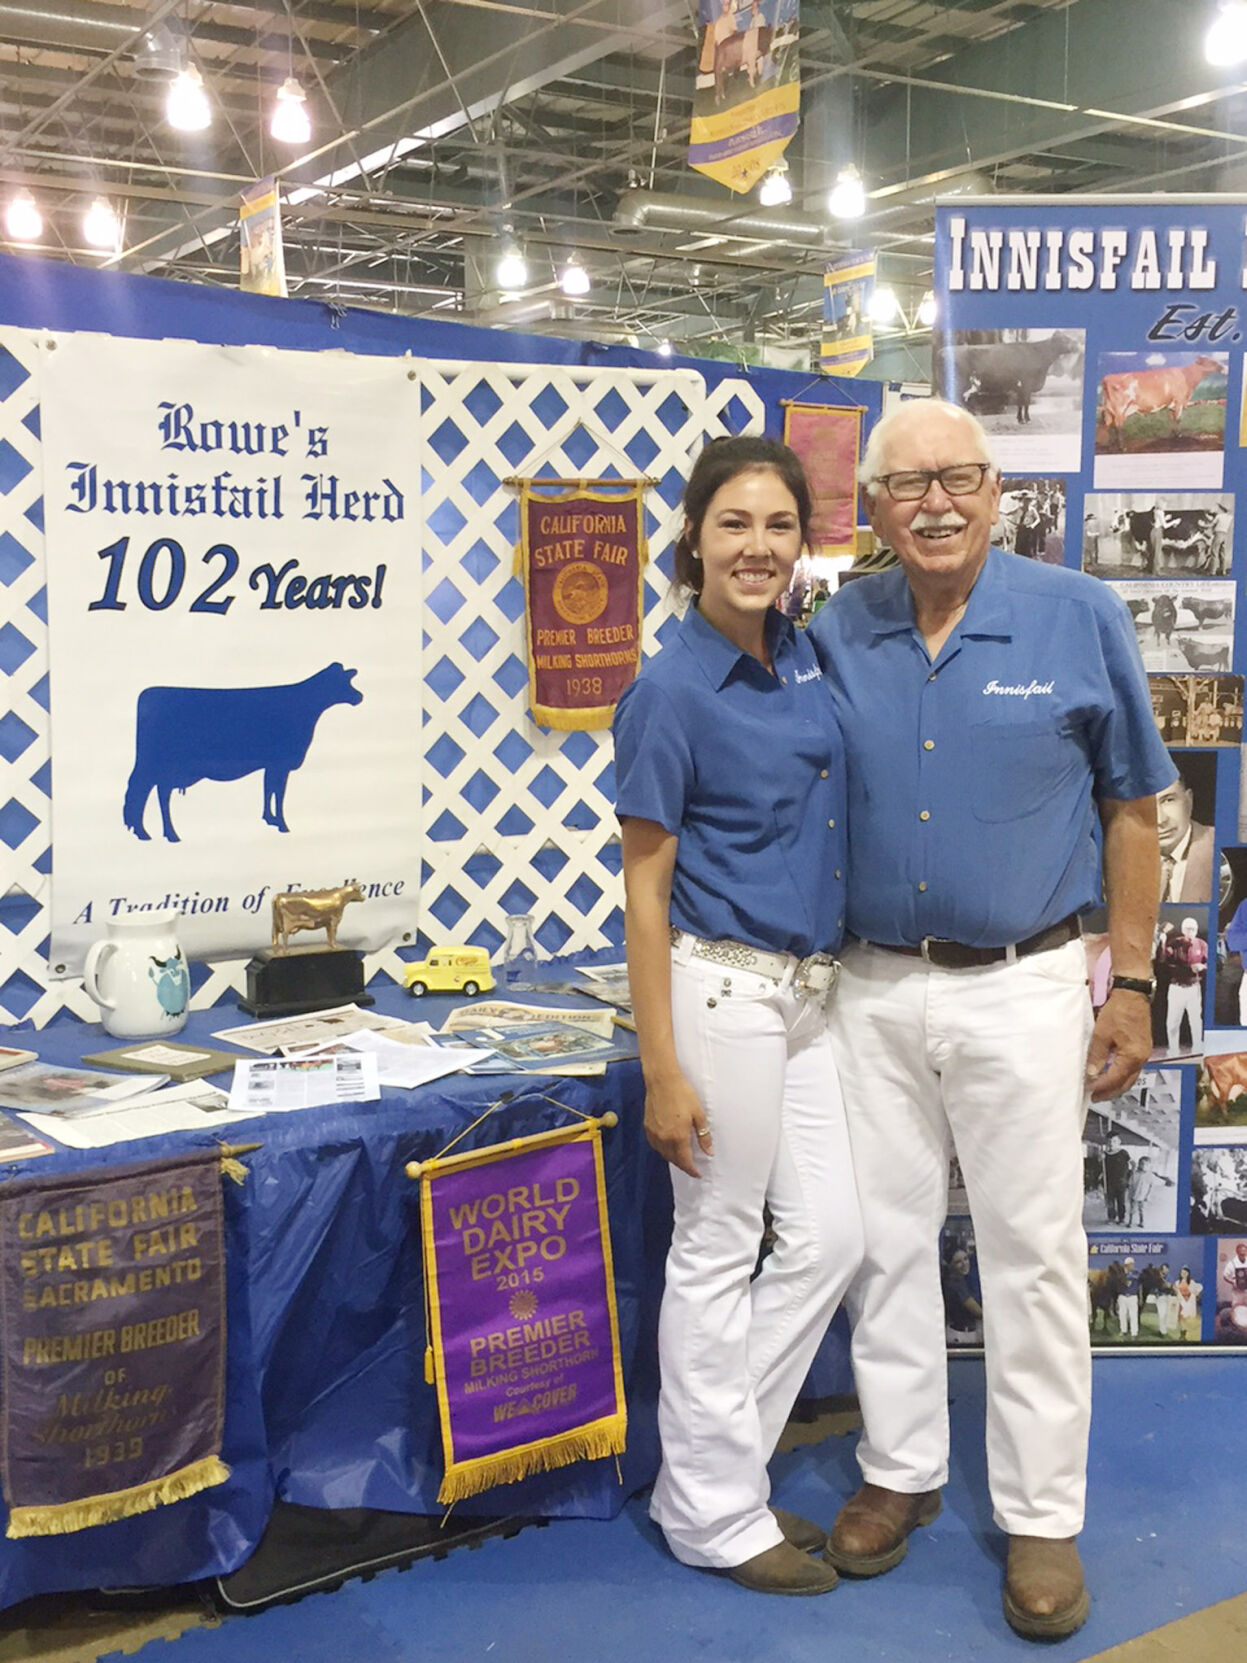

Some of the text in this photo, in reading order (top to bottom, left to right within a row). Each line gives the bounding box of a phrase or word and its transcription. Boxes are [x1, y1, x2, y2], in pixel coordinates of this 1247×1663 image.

[949, 217, 1217, 291] INNISFAIL
[1147, 303, 1241, 341] Est.
[157, 401, 330, 458] Rowe's
[64, 461, 405, 522] Innisfail Herd
[540, 514, 627, 535] CALIFORNIA
[87, 536, 387, 616] 102 Years!
[534, 539, 629, 567] STATE FAIR
[536, 624, 634, 646] PREMIER BREEDER
[535, 649, 638, 669] MILKING SHORTHORNS
[794, 663, 823, 684] Innisf
[566, 676, 603, 696] 1938
[982, 679, 1055, 700] Innisfail
[73, 900, 93, 924] A
[242, 885, 271, 914] of
[18, 1186, 198, 1240] CALIFORNIA
[448, 1177, 581, 1230] WORLD
[20, 1222, 199, 1279] STATE FAIR
[462, 1204, 572, 1256] DAIRY
[470, 1235, 567, 1281] EXPO
[496, 1266, 544, 1291] 2015
[22, 1257, 203, 1312] SACRAMENTO
[22, 1308, 201, 1366] PREMIER BREEDER
[469, 1310, 587, 1358] PREMIER
[470, 1330, 591, 1378] BREEDER
[104, 1368, 126, 1385] OF
[463, 1349, 599, 1395] MILKING SHORTHORN
[531, 1383, 578, 1411] COVER
